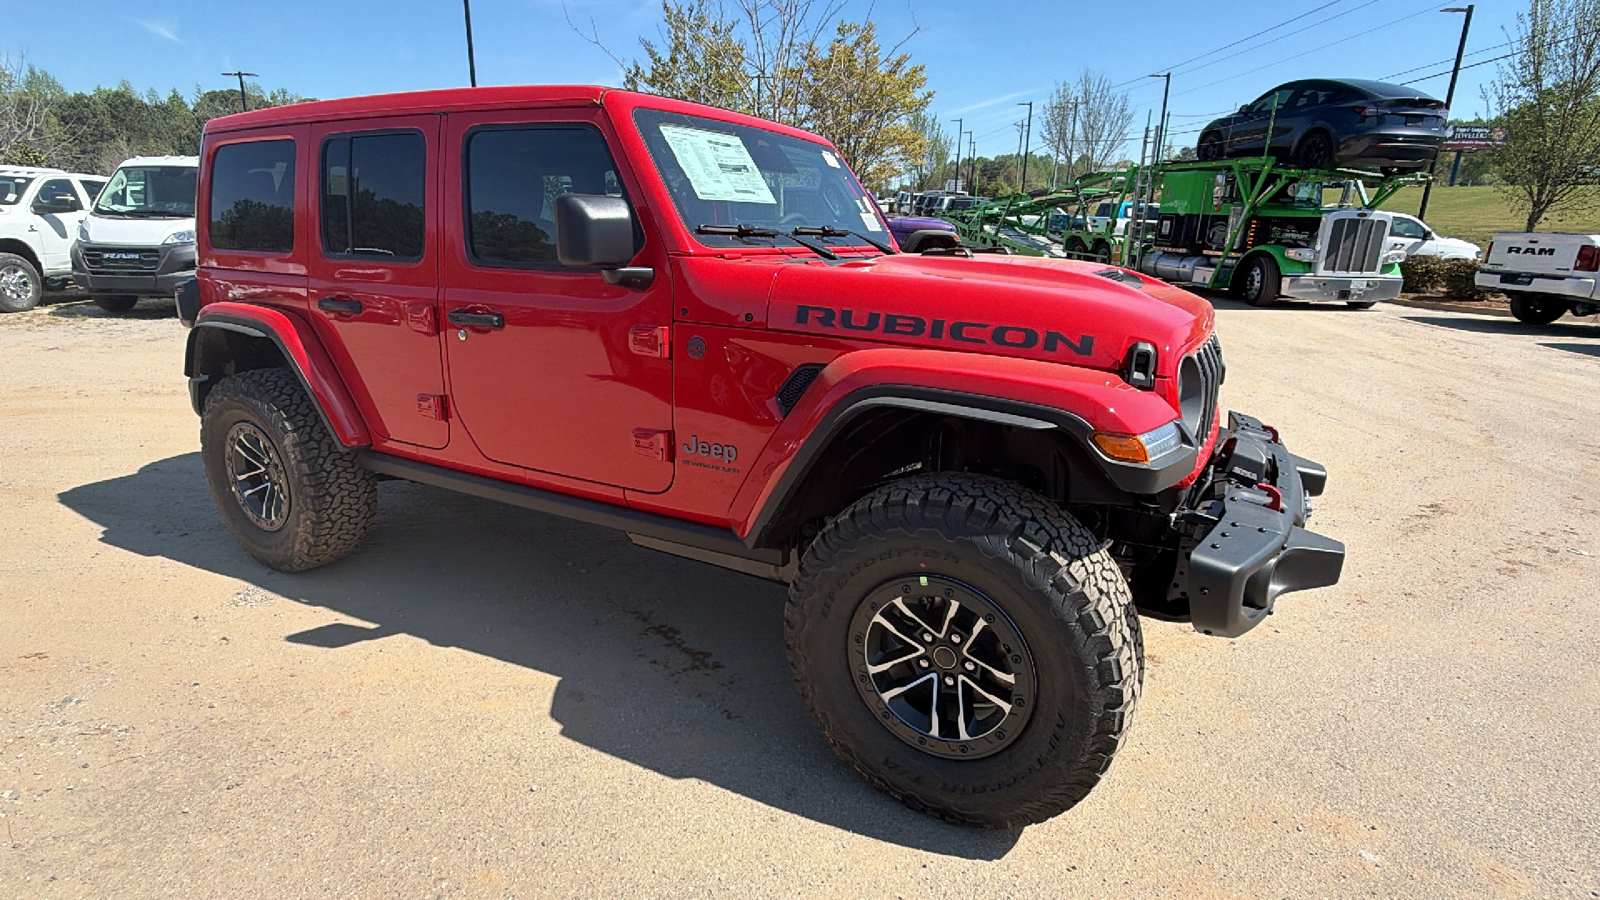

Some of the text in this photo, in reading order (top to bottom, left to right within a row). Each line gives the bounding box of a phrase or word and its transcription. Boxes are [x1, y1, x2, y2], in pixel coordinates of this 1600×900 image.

[1507, 246, 1556, 256] RAM
[795, 304, 1096, 357] RUBICON
[683, 434, 738, 465] Jeep
